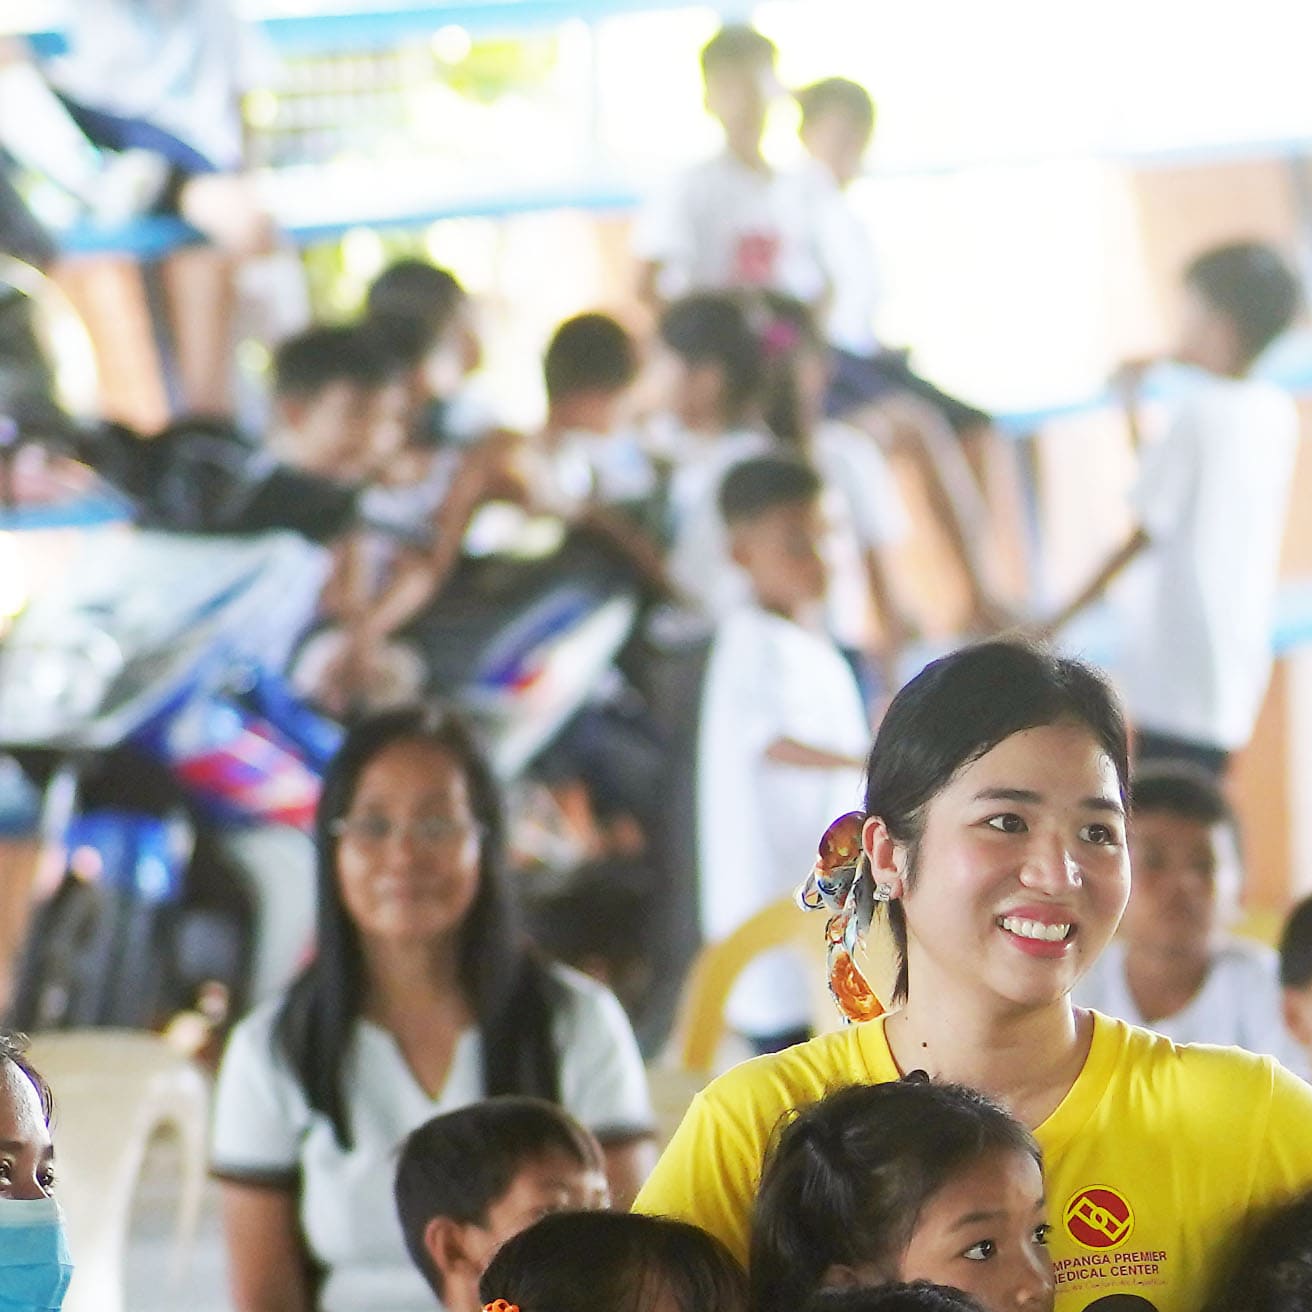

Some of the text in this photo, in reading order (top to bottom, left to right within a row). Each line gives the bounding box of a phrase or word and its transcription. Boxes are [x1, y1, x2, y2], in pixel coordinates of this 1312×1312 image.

[1053, 1250, 1167, 1272] MPANGA PREMIER
[1054, 1268, 1107, 1285] EDICAL
[1110, 1264, 1159, 1277] CENTER
